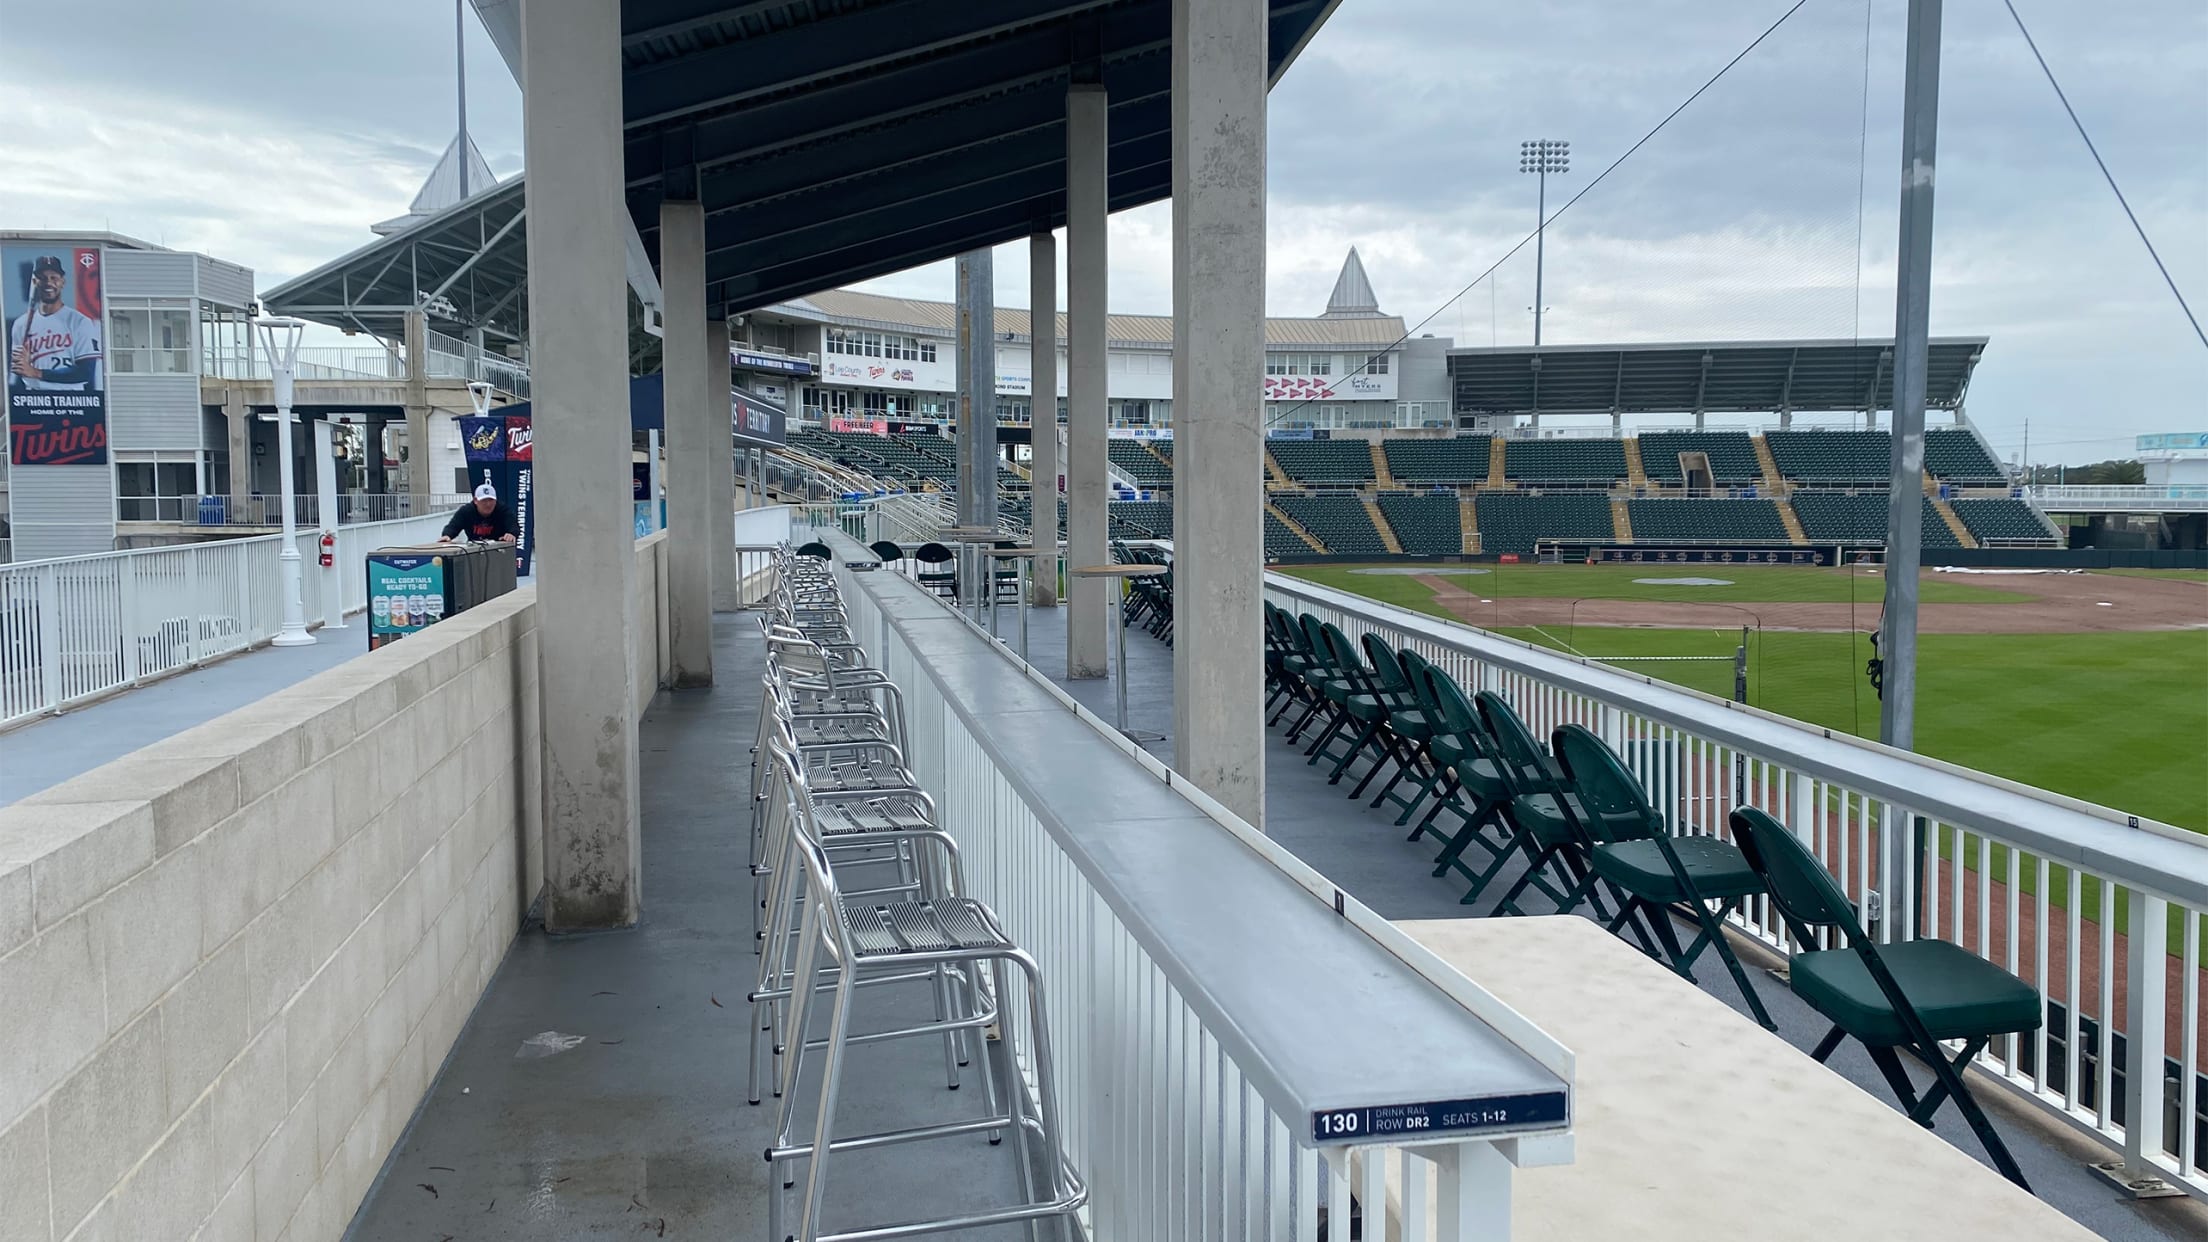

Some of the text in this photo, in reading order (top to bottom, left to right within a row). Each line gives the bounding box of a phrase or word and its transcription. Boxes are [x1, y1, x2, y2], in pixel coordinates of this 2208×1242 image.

[13, 395, 100, 407] SPRING TRAINING
[746, 408, 770, 433] TERRITORY
[10, 419, 106, 464] Twins
[516, 469, 527, 550] TWINS TERRITORY
[2130, 818, 2137, 827] 15
[1376, 1107, 1427, 1117] DRINK RAIL
[1376, 1110, 1507, 1130] ROW DR2 SEATS 1-12
[1322, 1113, 1358, 1134] 130
